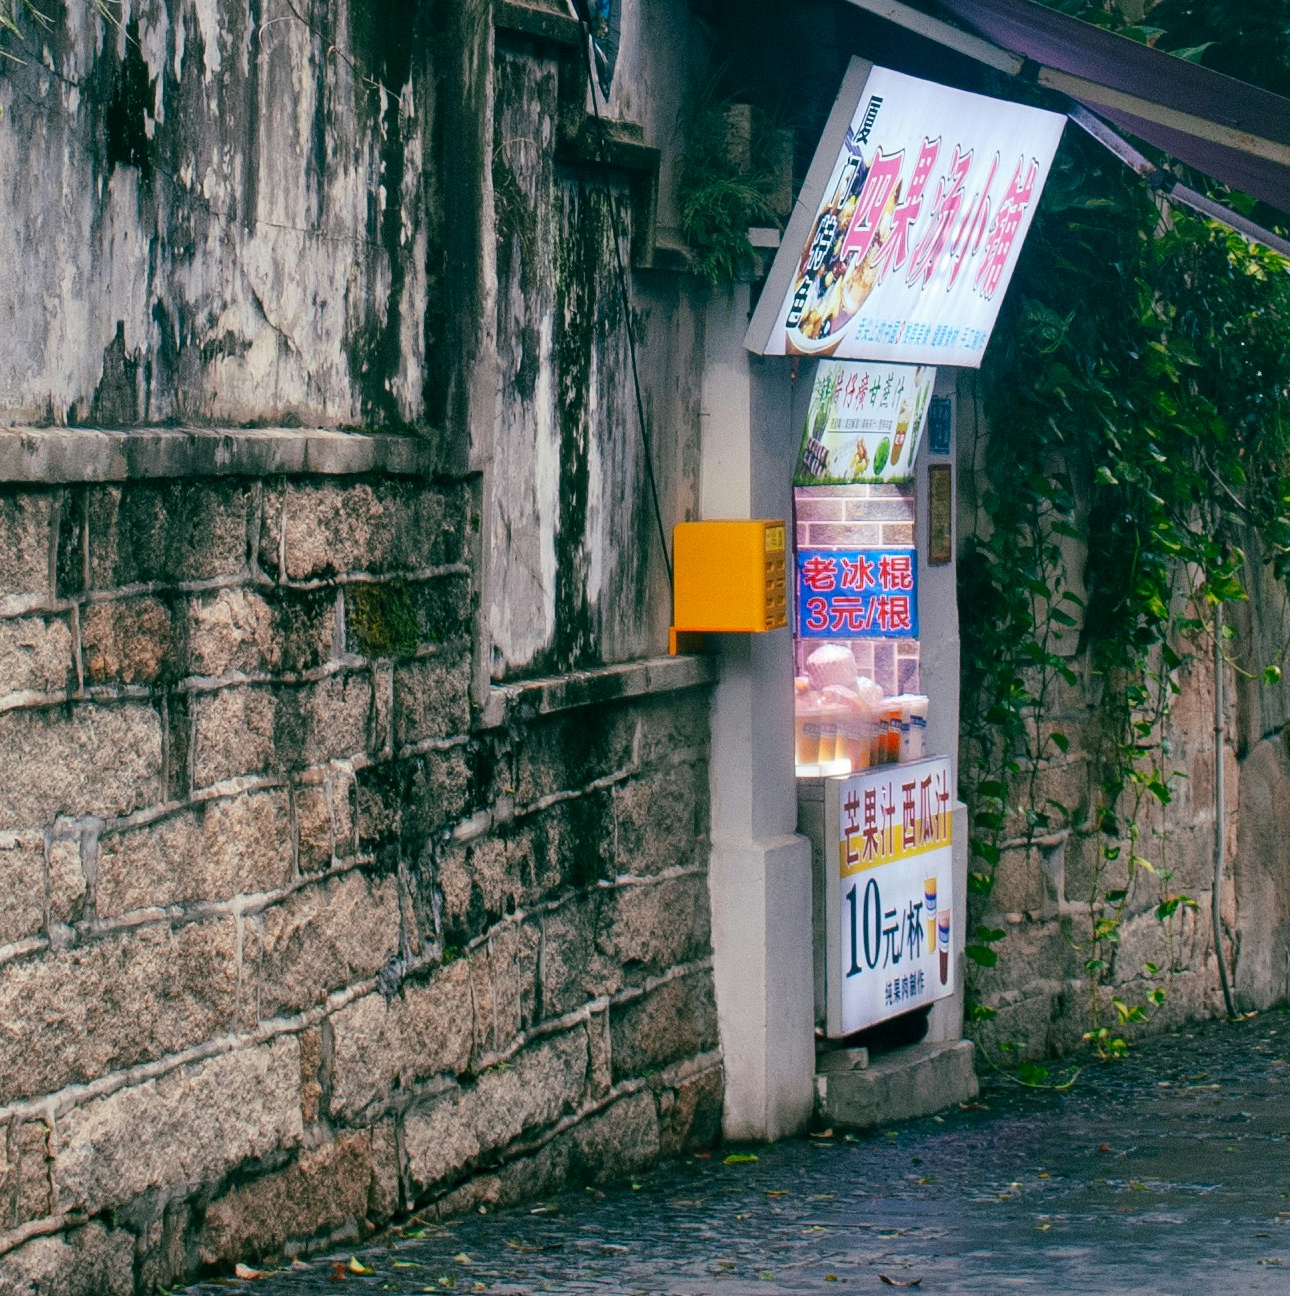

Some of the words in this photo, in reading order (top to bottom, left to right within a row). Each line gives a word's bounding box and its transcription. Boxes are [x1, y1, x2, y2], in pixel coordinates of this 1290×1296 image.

[785, 94, 884, 329] 厦门特色
[840, 135, 1040, 301] 四果汤小铺
[803, 555, 913, 592] 老冰棍
[806, 594, 911, 631] 3元/根
[843, 781, 896, 867] 芒果汁
[901, 769, 950, 851] 西瓜汁
[845, 877, 924, 979] 10元/杯
